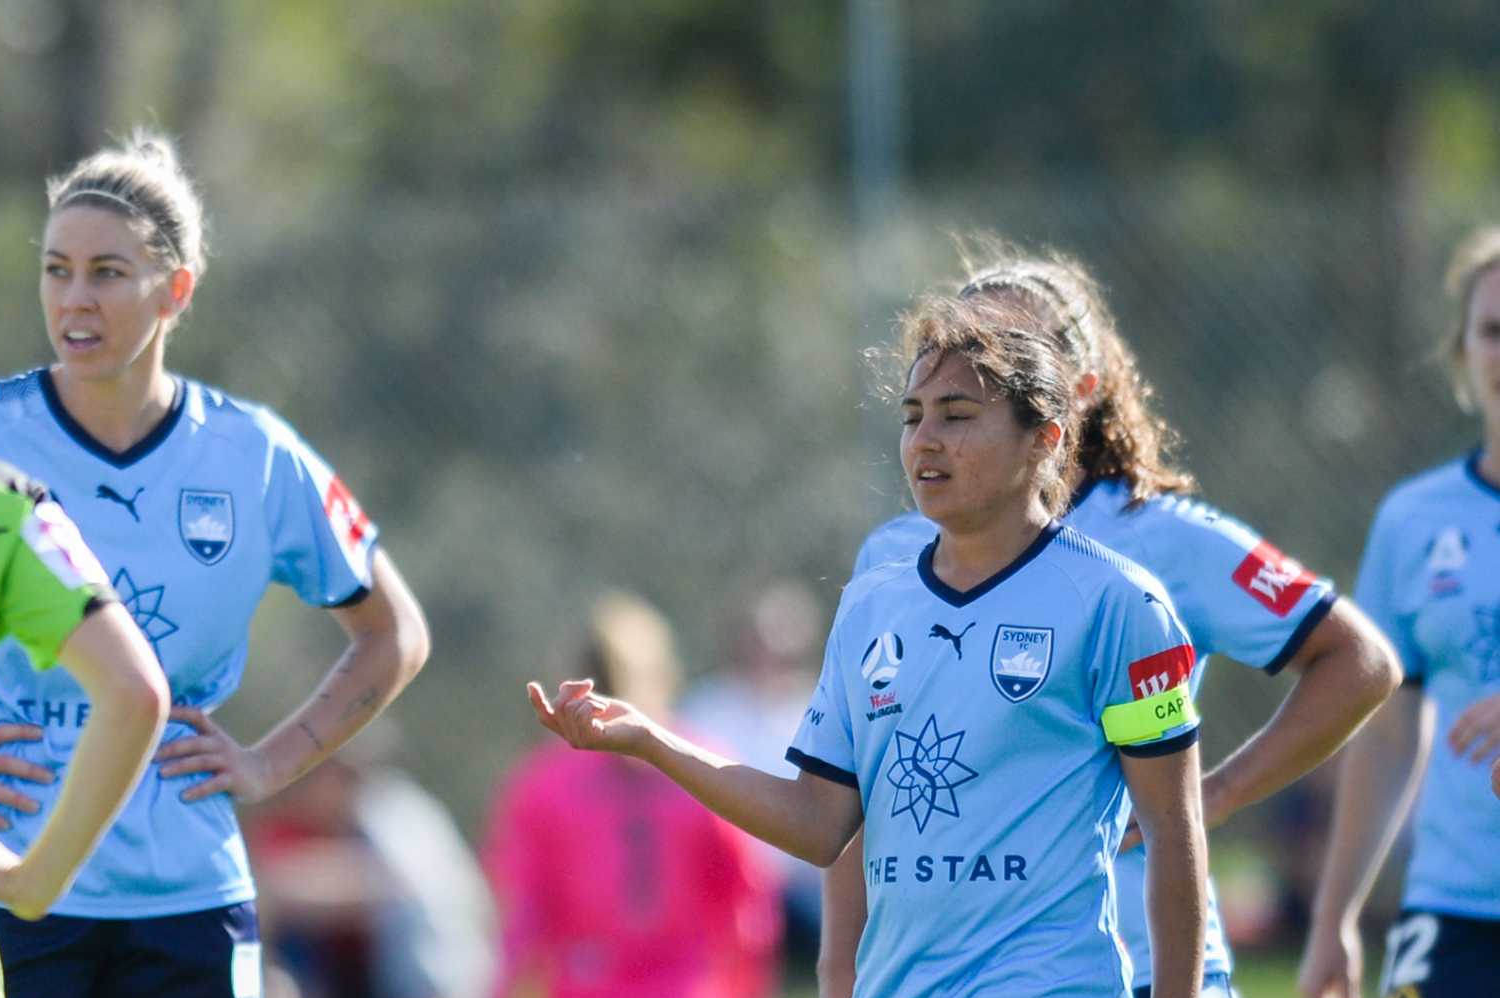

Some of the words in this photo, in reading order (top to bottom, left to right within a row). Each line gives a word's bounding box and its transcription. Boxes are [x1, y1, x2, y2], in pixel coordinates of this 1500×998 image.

[1002, 630, 1047, 644] SYDNEY
[868, 857, 898, 888] THE
[915, 854, 1028, 883] STAR
